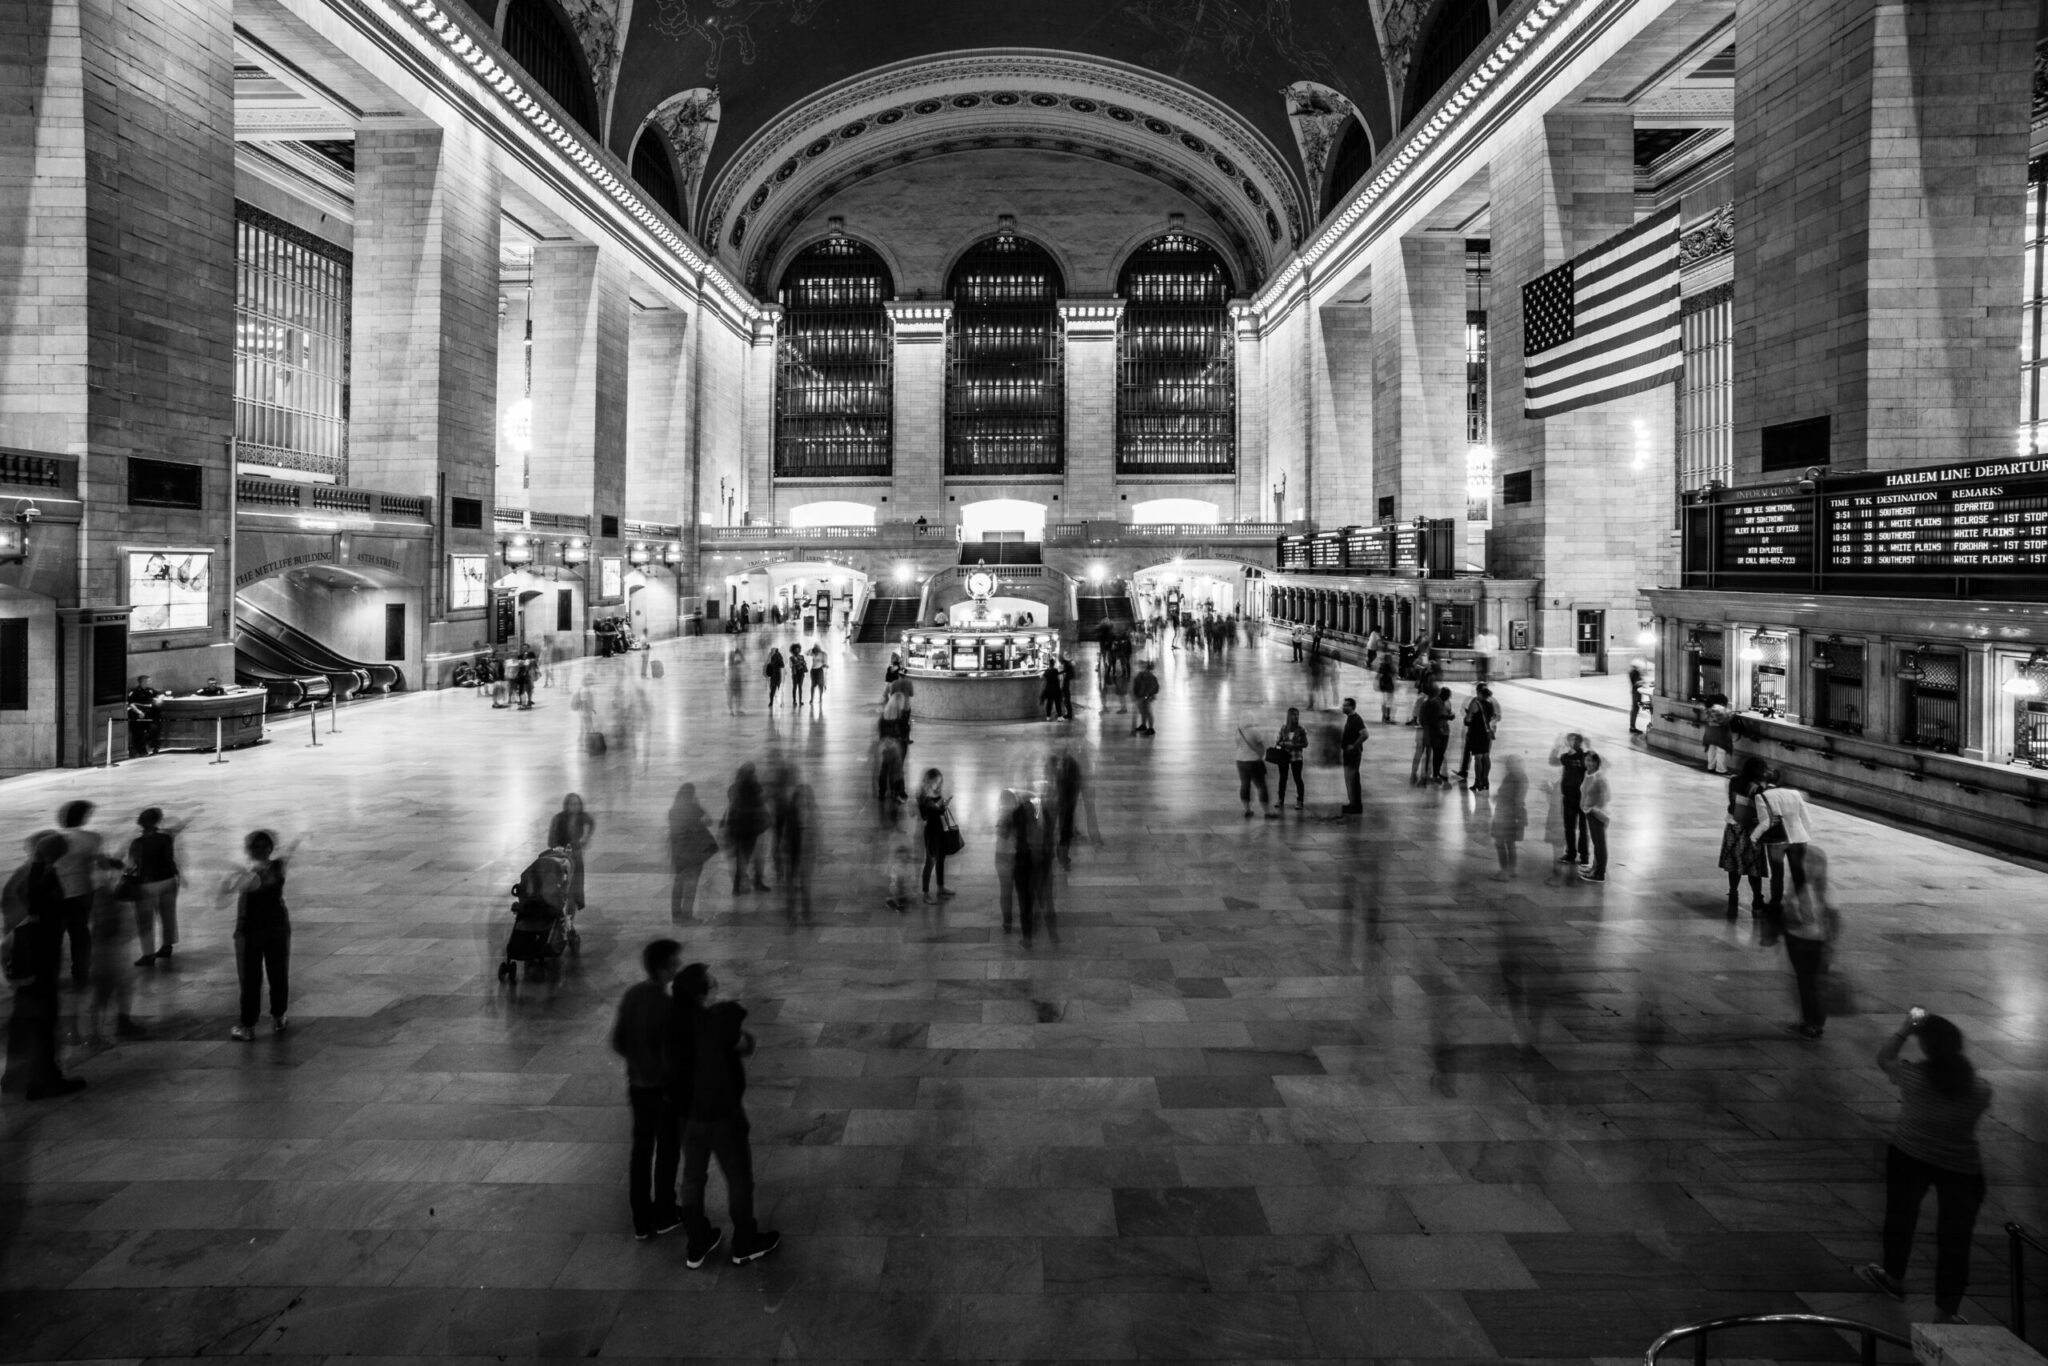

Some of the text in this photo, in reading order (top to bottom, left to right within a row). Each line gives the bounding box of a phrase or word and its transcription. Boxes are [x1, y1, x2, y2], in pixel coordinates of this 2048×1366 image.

[1886, 471, 1938, 486] HARLEM
[1940, 468, 1972, 480] LINE
[1831, 487, 2004, 507] TIME TRK DESTINATION REMARKS
[1879, 506, 1916, 516] SOUTHEAST
[1954, 501, 1994, 512] DEPARTED
[1890, 519, 1912, 527] WHITE
[1914, 517, 1942, 526] PLAINS
[1954, 515, 1989, 525] MELROSE
[2004, 514, 2020, 523] 1ST
[2024, 512, 2048, 521] STOP
[1878, 531, 1916, 540] SOUTHEAST
[1954, 528, 1979, 538] WHITE
[1982, 527, 2015, 537] PLAINS
[2030, 526, 2048, 535] 1ST
[1890, 543, 1912, 551] WHITE
[1914, 542, 1942, 551] PLAINS
[1953, 541, 1989, 551] FORDHAM
[2004, 541, 2020, 550] 1ST
[2024, 540, 2048, 549] STOP
[255, 557, 293, 577] METLIFE
[294, 552, 332, 565] BUILDING
[376, 555, 400, 569] STREET
[1878, 555, 1916, 564] SOUTHEAST
[1953, 555, 1979, 564] WHITE
[1982, 554, 2014, 564] PLAINS
[2029, 554, 2048, 563] 1ST
